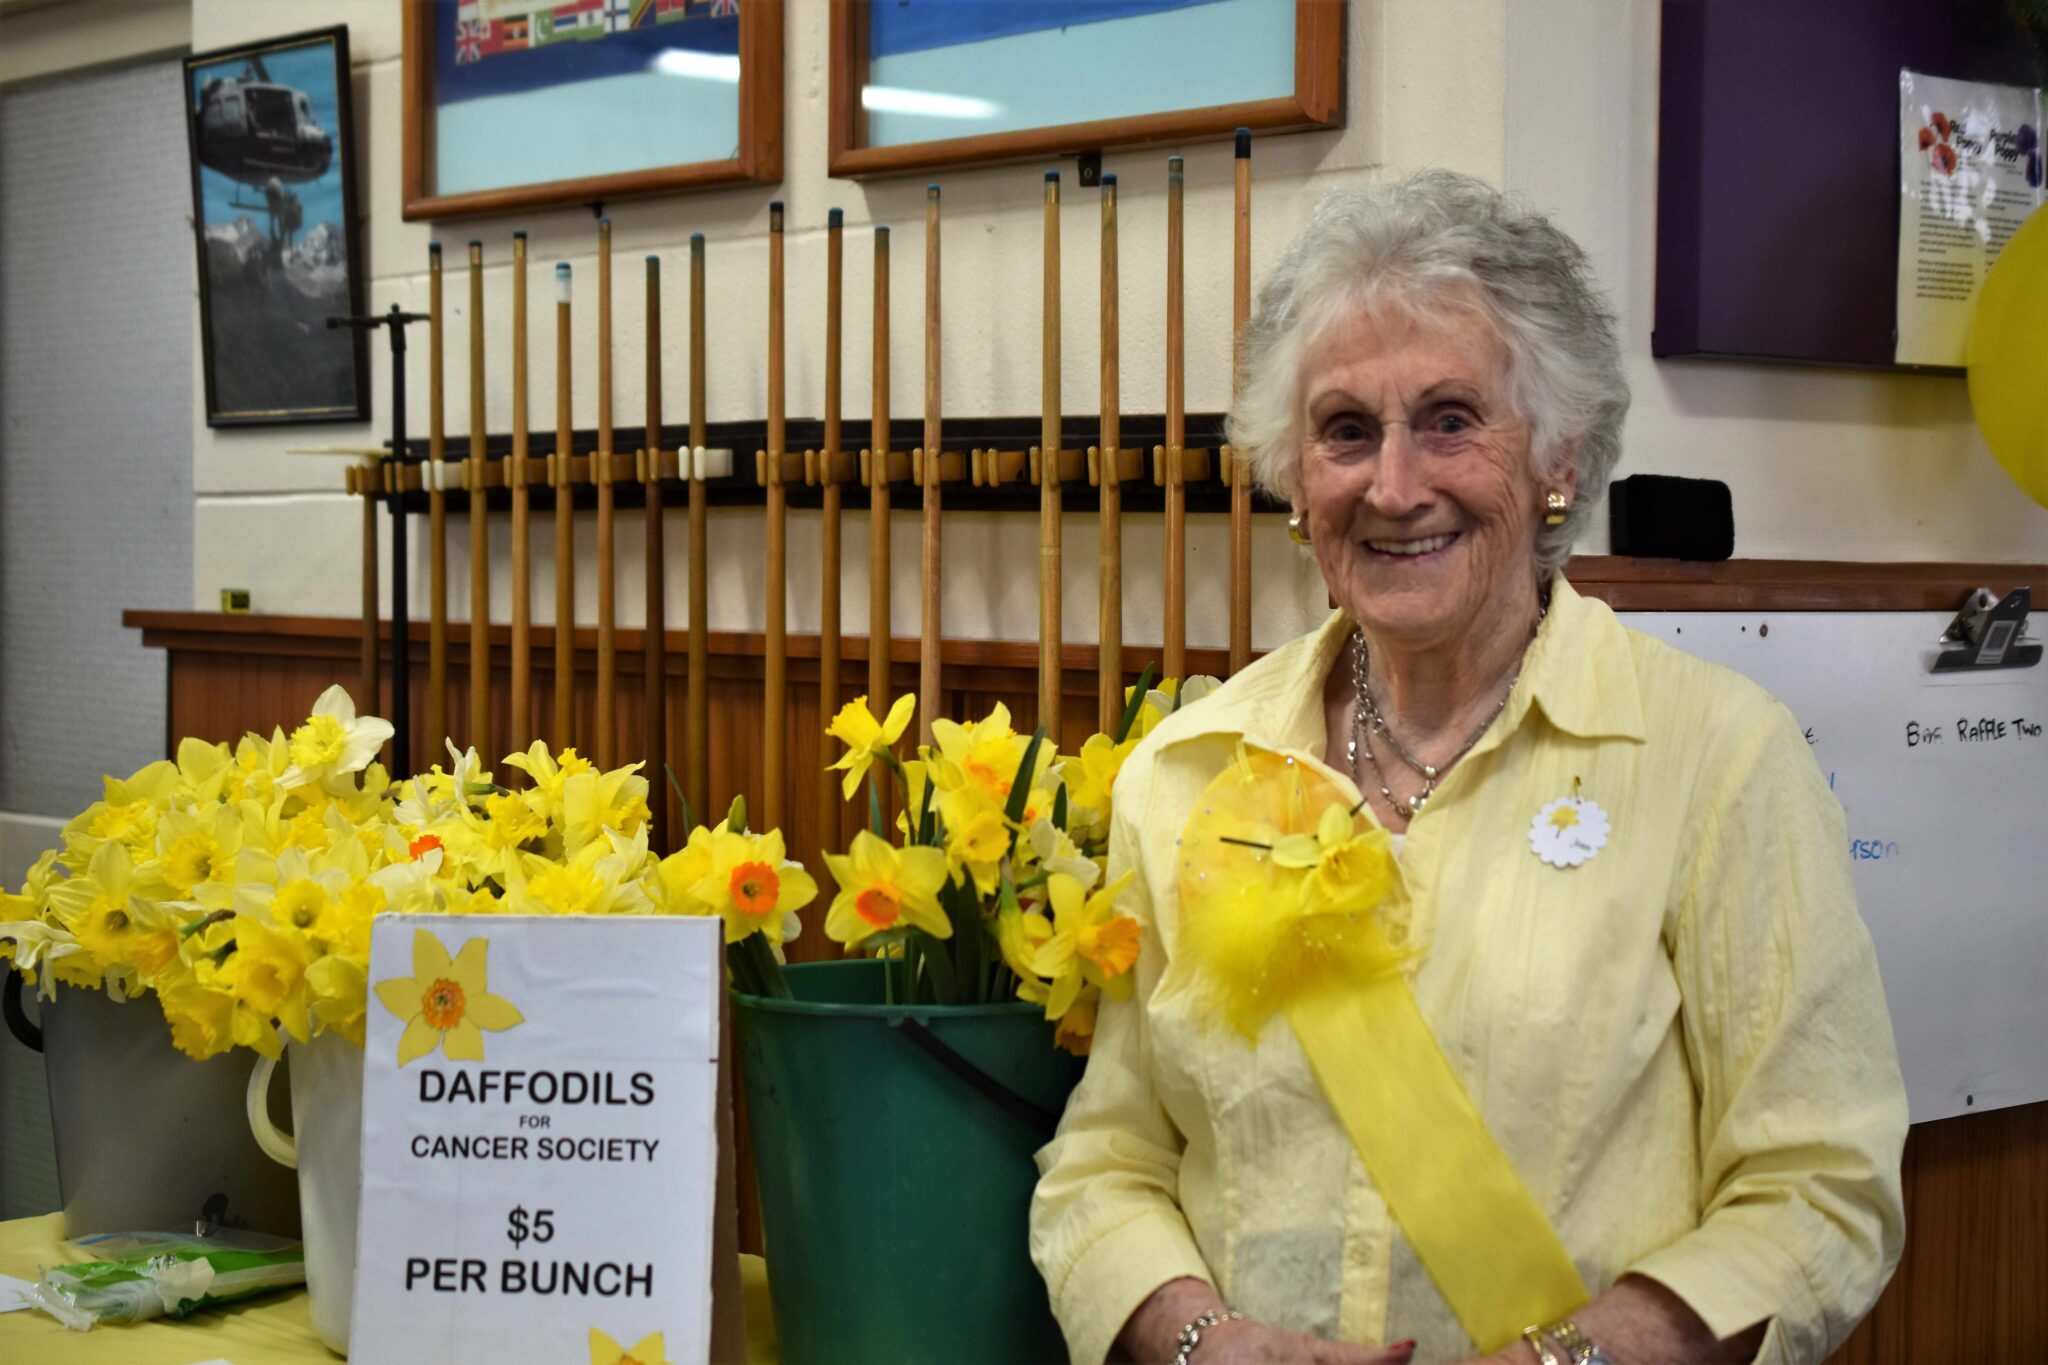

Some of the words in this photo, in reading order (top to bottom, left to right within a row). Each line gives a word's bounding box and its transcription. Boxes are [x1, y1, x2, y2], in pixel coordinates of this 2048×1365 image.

[1849, 838, 1899, 861] rson
[419, 1069, 655, 1106] DAFFODILS
[519, 1114, 551, 1130] FOR
[410, 1135, 529, 1160] CANCER
[537, 1137, 660, 1162] SOCIETY
[506, 1204, 555, 1250] $5
[405, 1257, 488, 1294] PER
[500, 1259, 654, 1298] BUNCH
